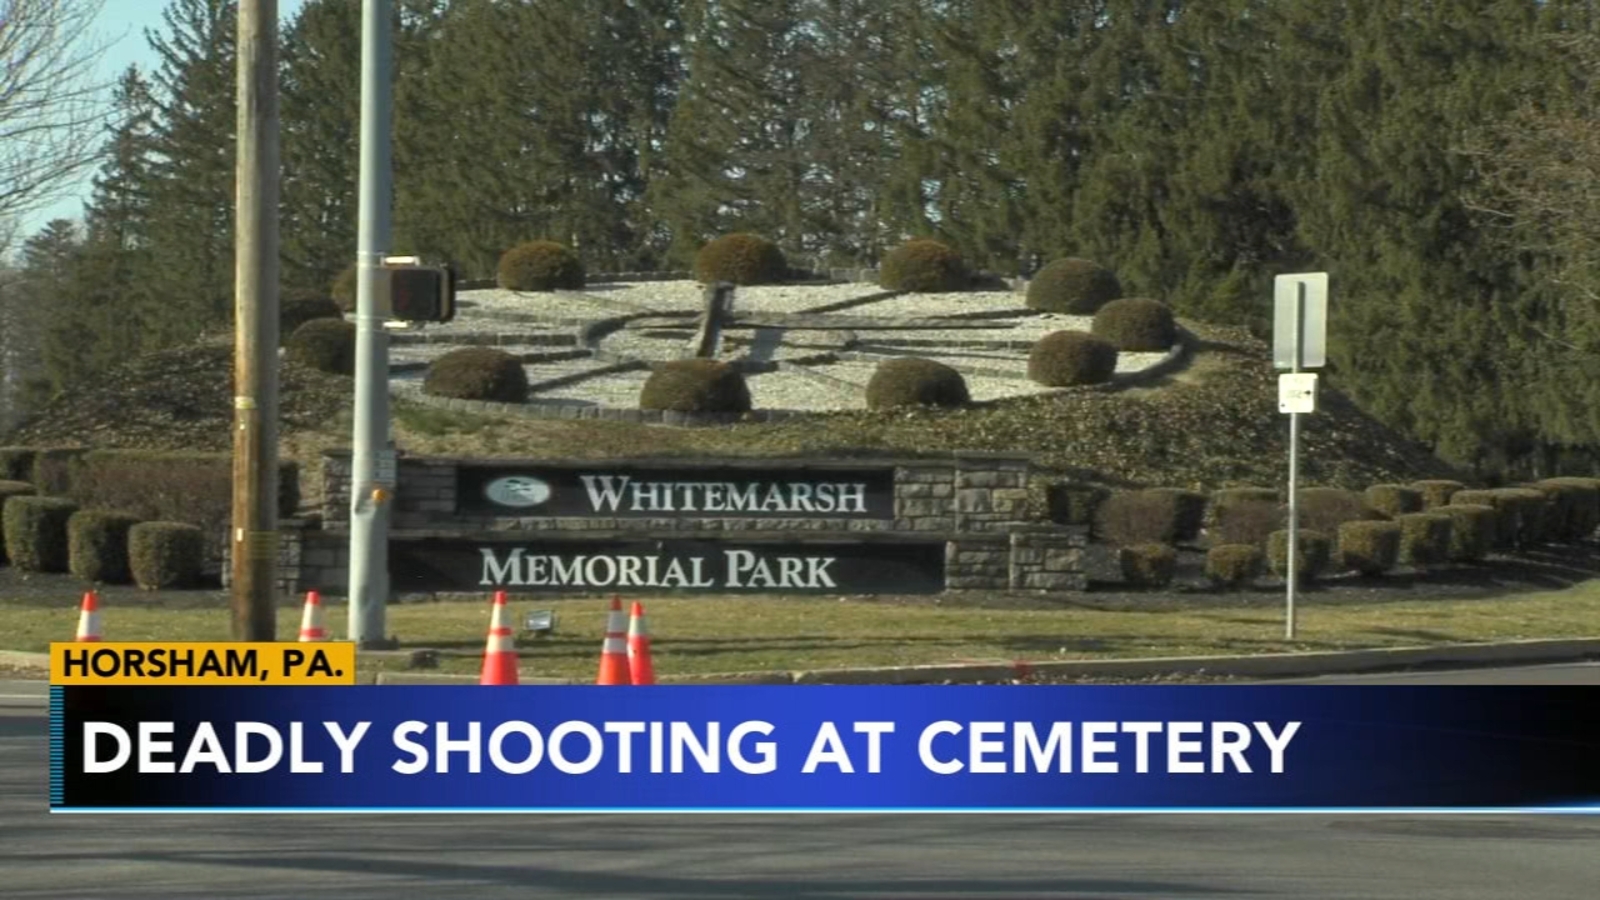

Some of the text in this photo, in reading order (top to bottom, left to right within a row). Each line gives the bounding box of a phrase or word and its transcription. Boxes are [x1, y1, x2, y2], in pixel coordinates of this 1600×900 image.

[580, 474, 868, 512] WHITEMARSH
[479, 548, 836, 588] MEMORIAL PARK
